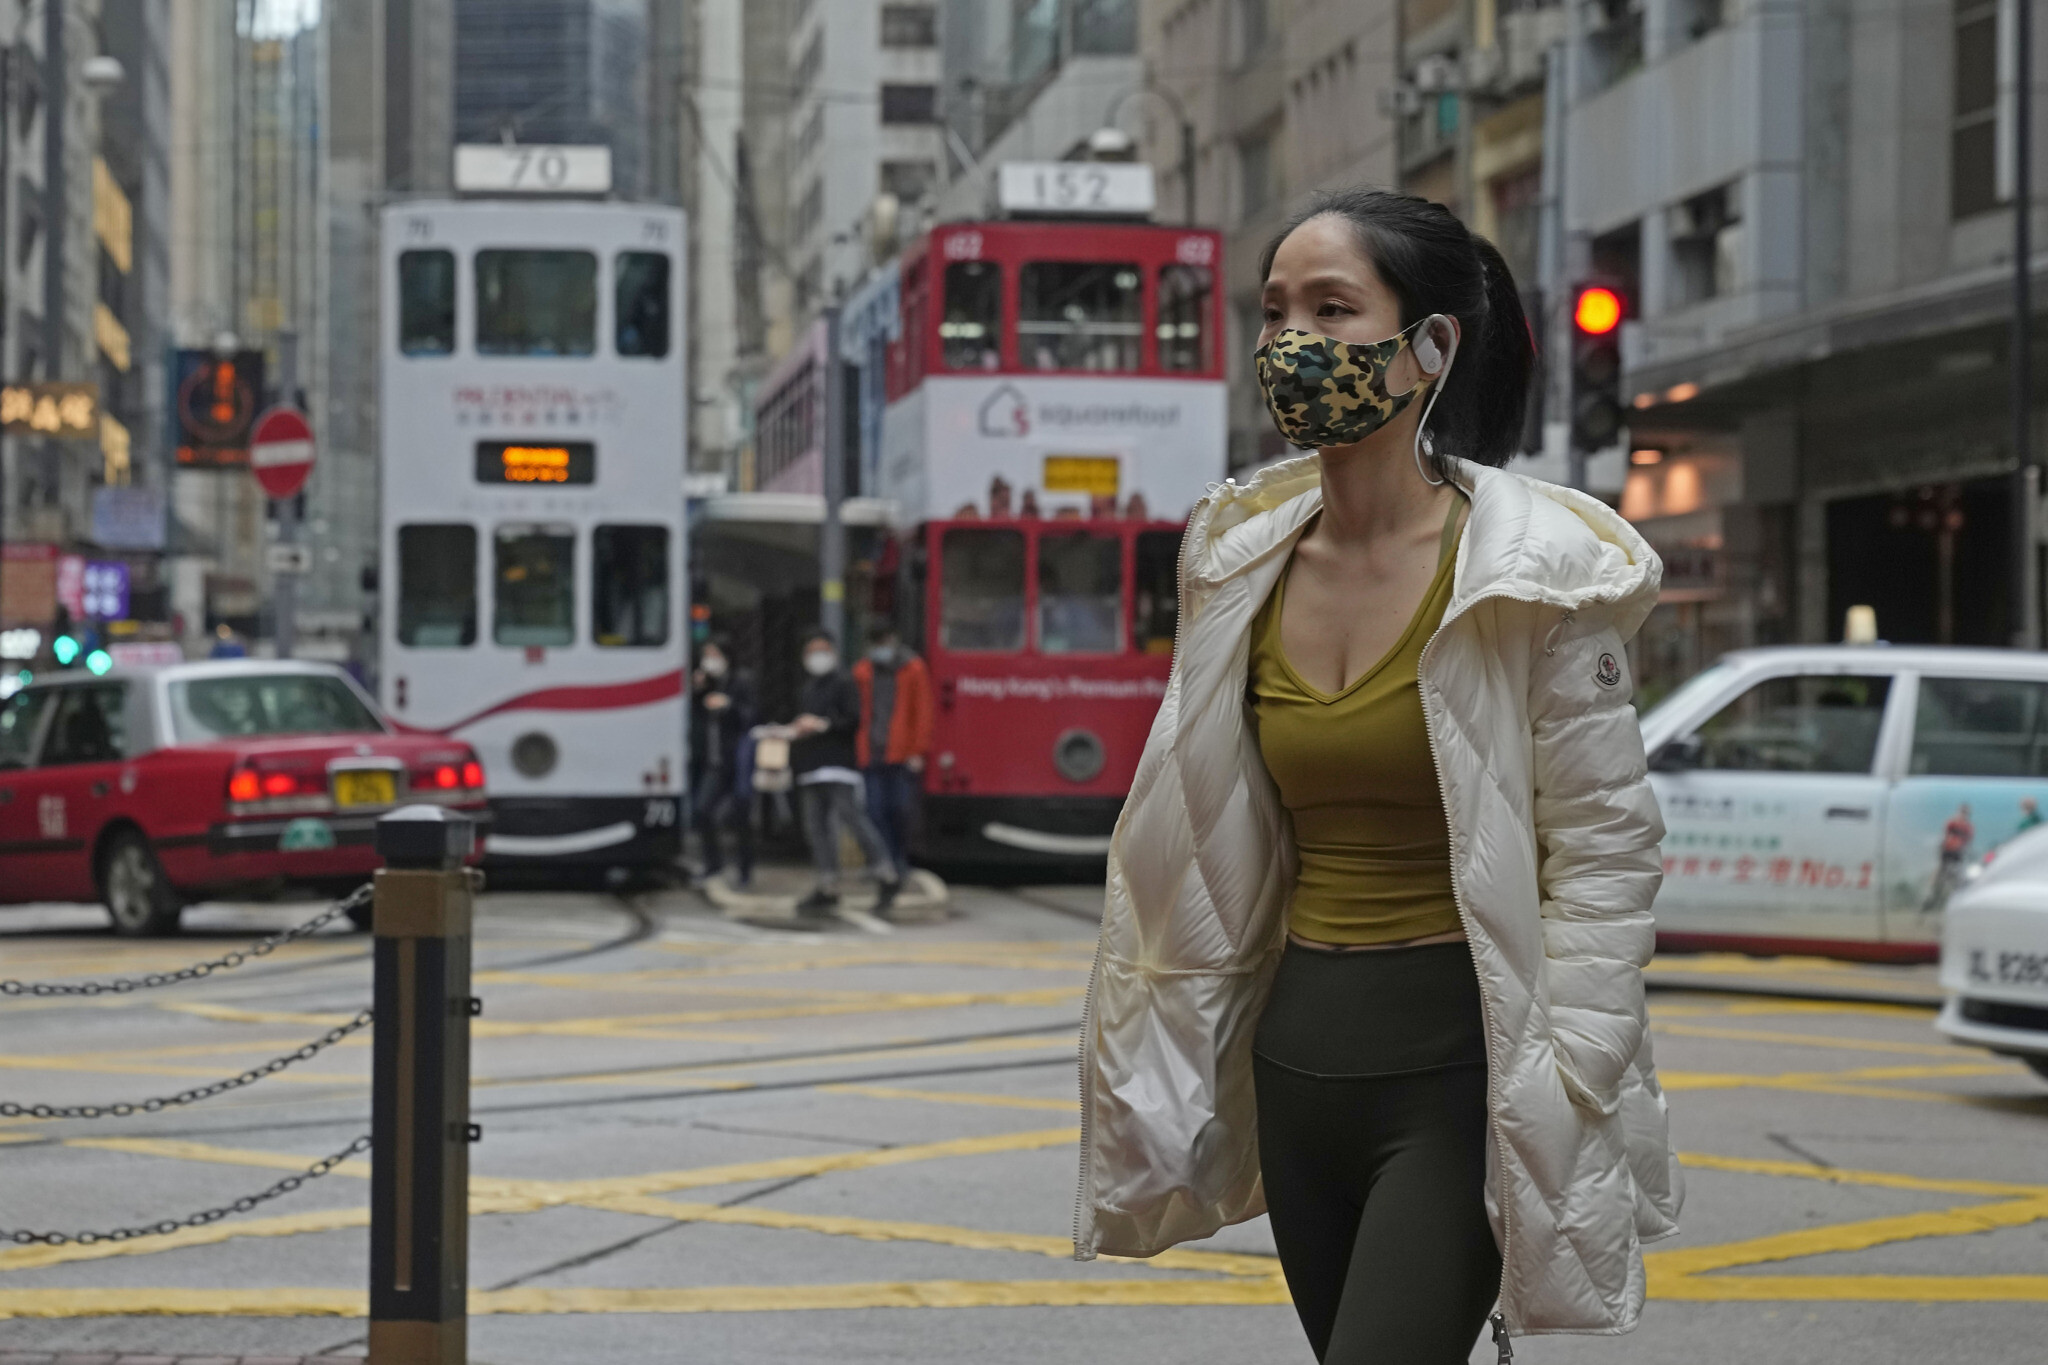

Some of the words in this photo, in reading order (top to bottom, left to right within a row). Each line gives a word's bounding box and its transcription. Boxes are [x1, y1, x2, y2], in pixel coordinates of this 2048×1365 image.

[506, 149, 568, 188] 70
[1033, 171, 1110, 206] 152
[944, 231, 983, 260] 152
[1175, 235, 1214, 265] 152
[1038, 403, 1181, 427] squarefoot
[957, 676, 1003, 701] Hong
[1006, 676, 1065, 701] Kong's
[1069, 676, 1137, 698] Premium
